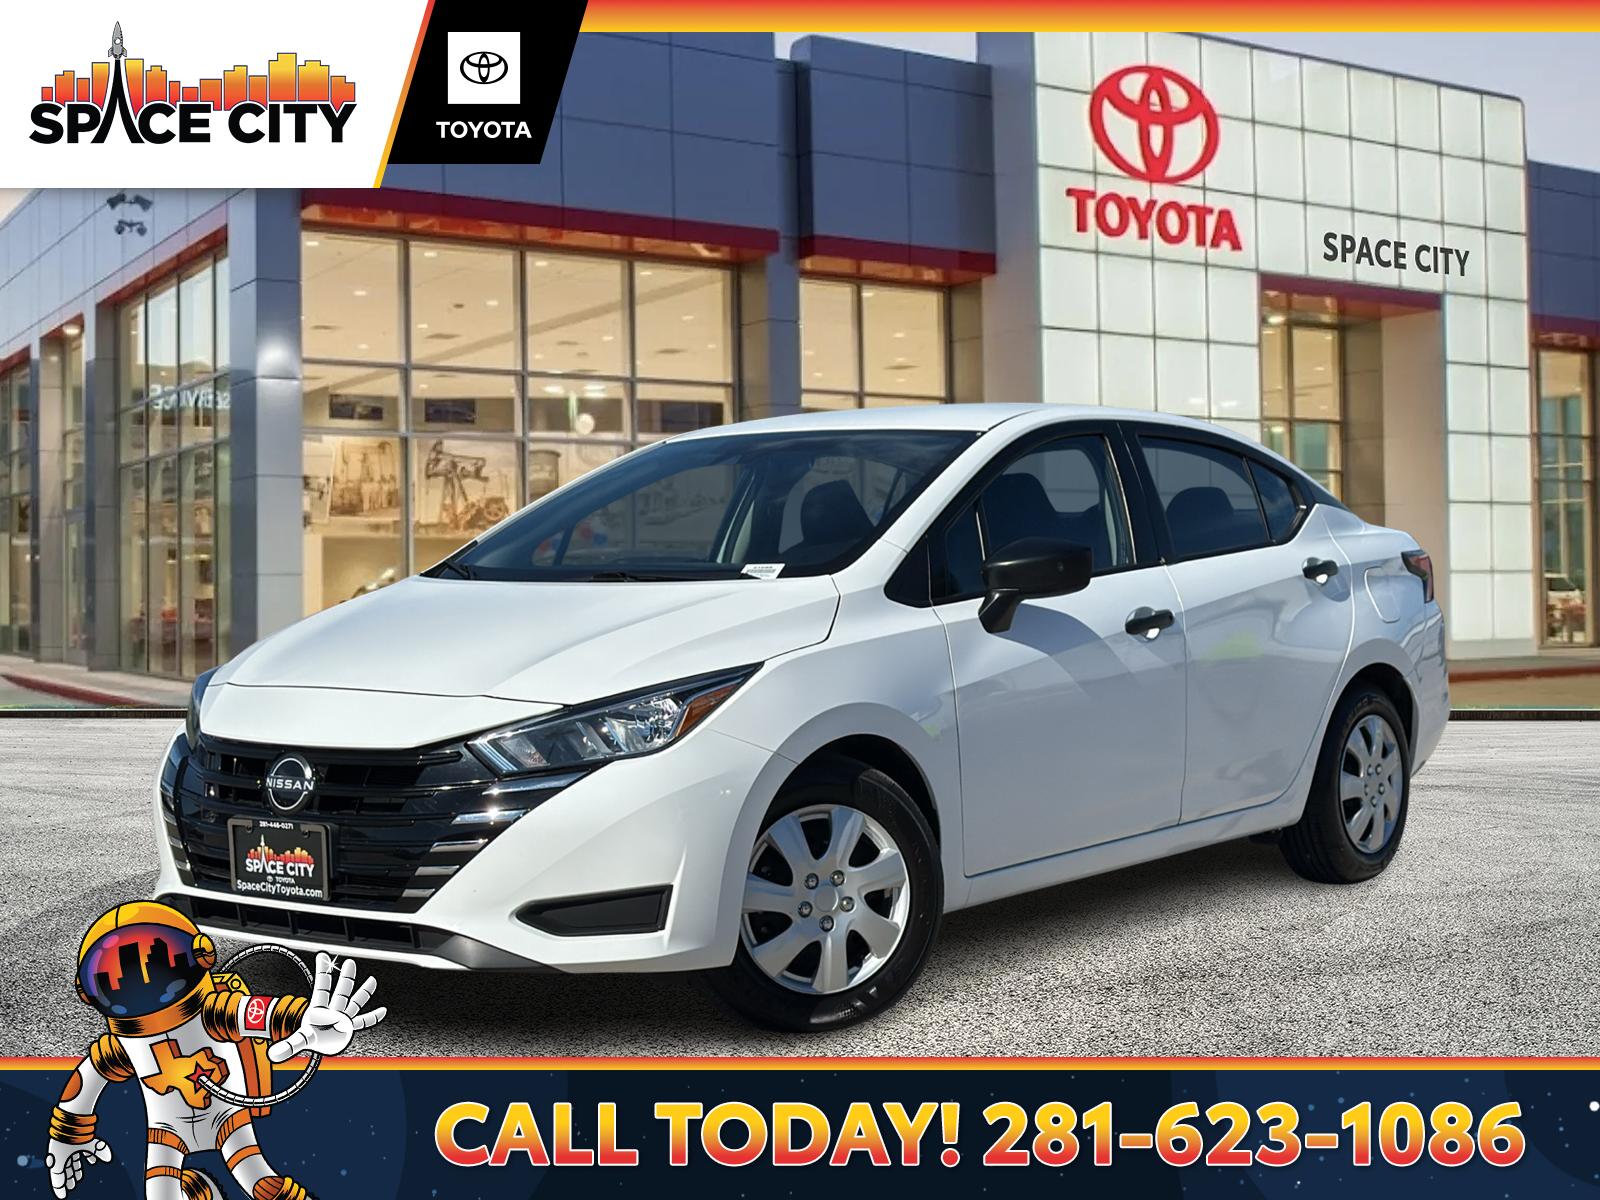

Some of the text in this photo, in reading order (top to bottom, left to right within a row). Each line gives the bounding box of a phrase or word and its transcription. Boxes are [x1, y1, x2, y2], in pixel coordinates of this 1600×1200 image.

[1066, 188, 1242, 251] TOYOTA
[1323, 232, 1470, 276] SPACE CITY
[266, 778, 314, 791] NISSAN
[246, 858, 315, 877] SPACE CITY
[237, 879, 322, 898] SpaceCityToyota.com
[275, 876, 296, 884] TOYOTA
